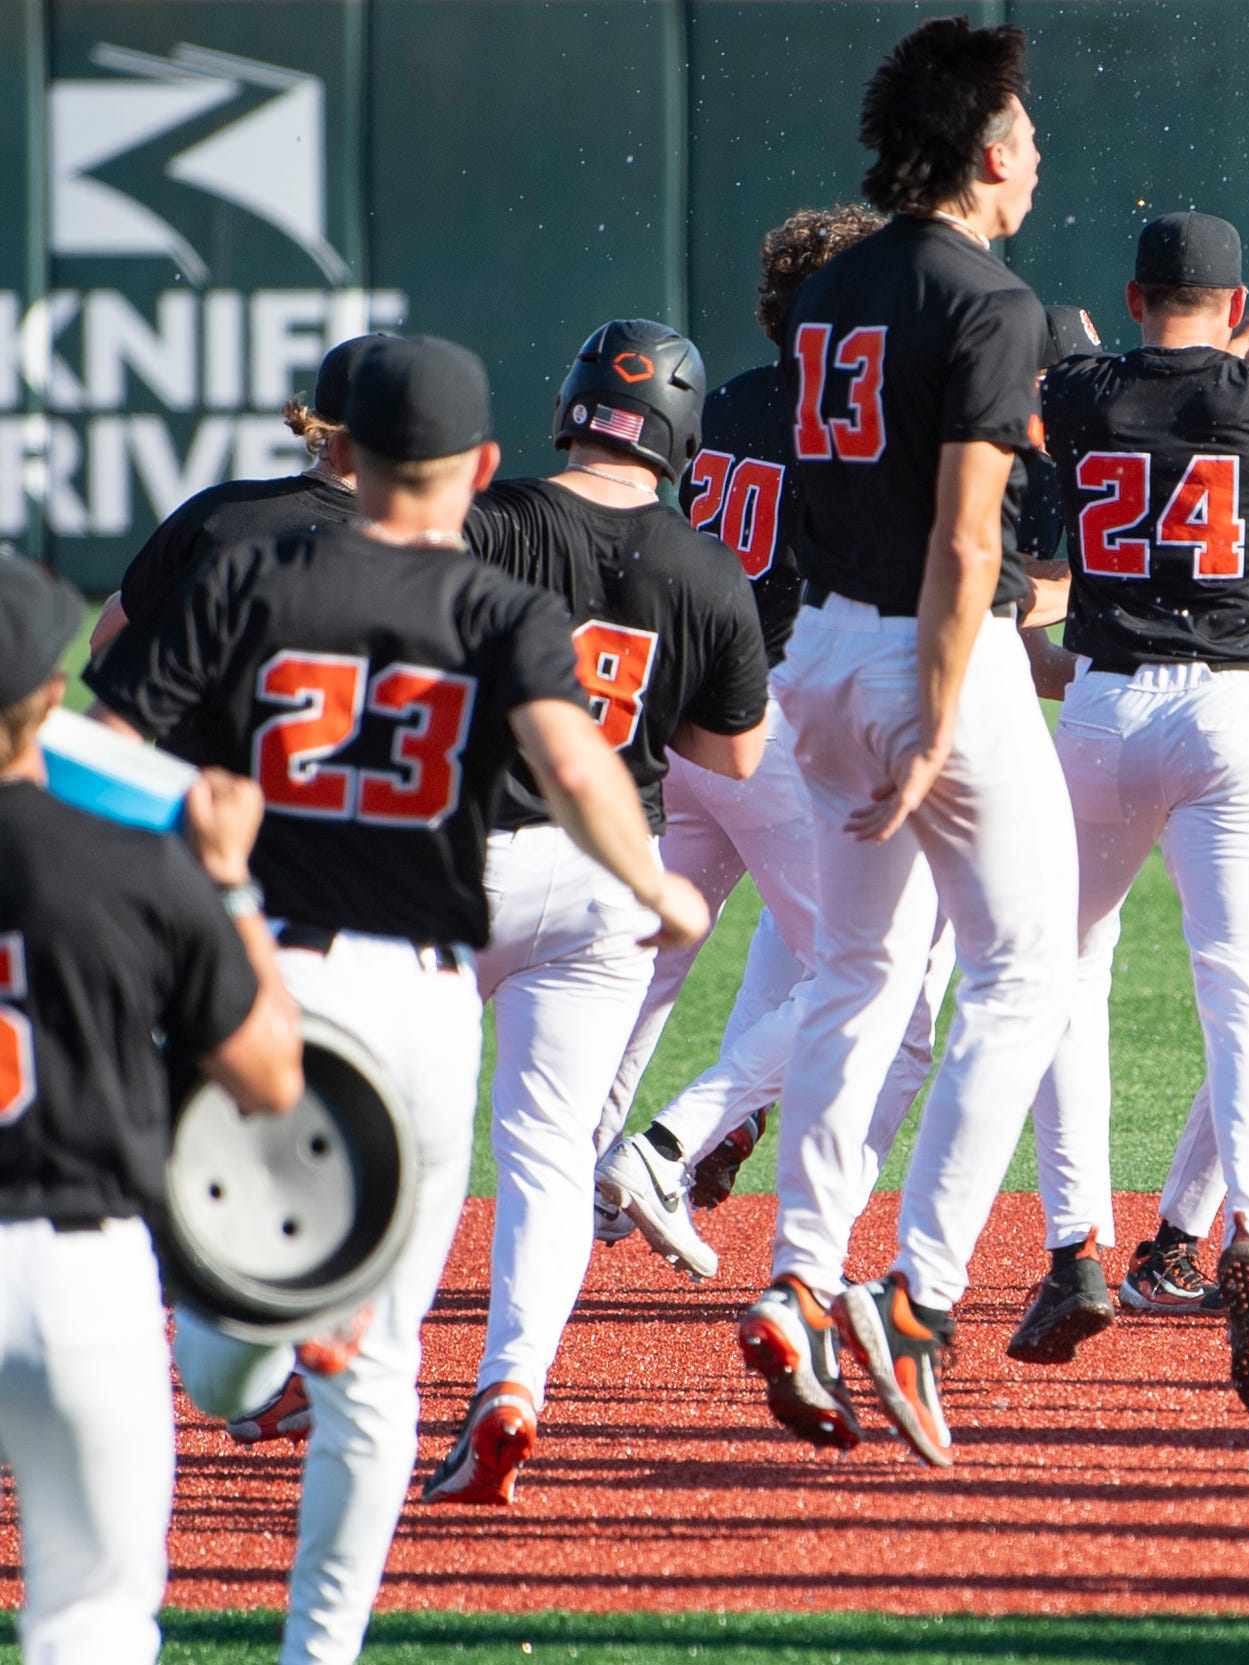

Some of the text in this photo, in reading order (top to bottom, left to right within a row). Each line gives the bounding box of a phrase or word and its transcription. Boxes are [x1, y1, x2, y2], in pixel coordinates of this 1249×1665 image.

[795, 323, 888, 462] 13
[691, 449, 786, 581] 20
[1076, 452, 1246, 579] 24
[251, 648, 476, 829] 23
